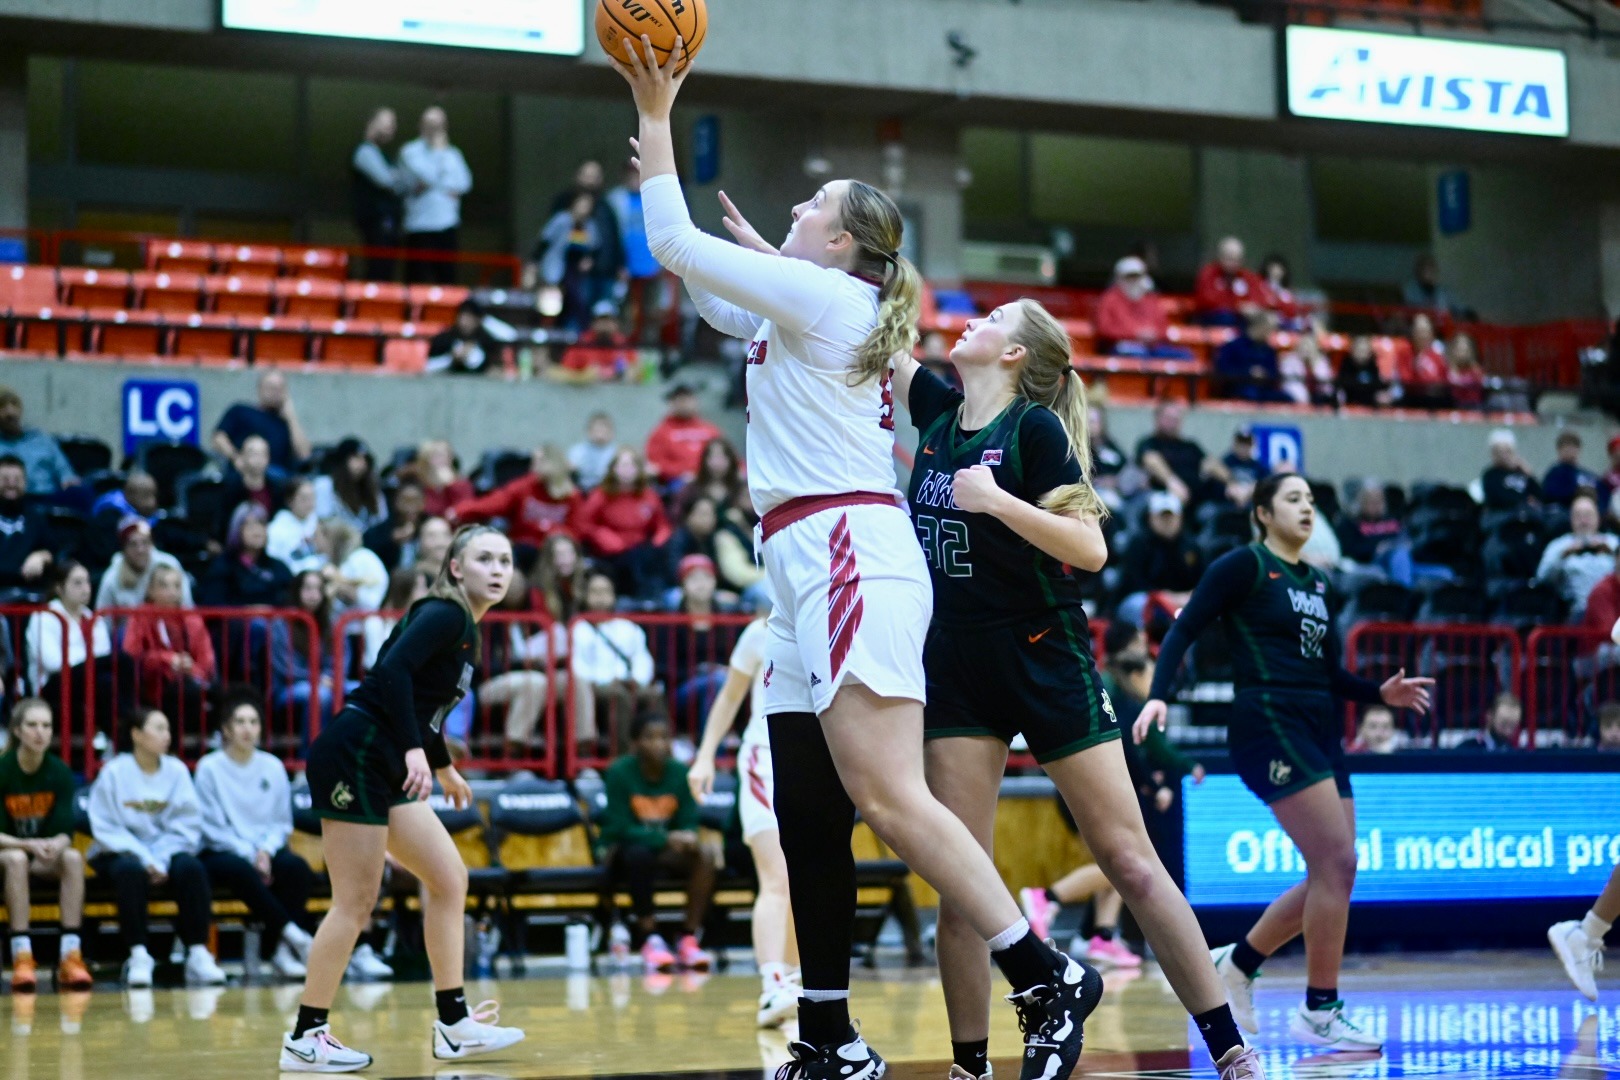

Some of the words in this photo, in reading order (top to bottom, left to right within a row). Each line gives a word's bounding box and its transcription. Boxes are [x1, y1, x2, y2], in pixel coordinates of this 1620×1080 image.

[127, 386, 194, 441] LC
[1268, 432, 1298, 472] D
[917, 514, 973, 577] 32
[1395, 826, 1554, 870] medical
